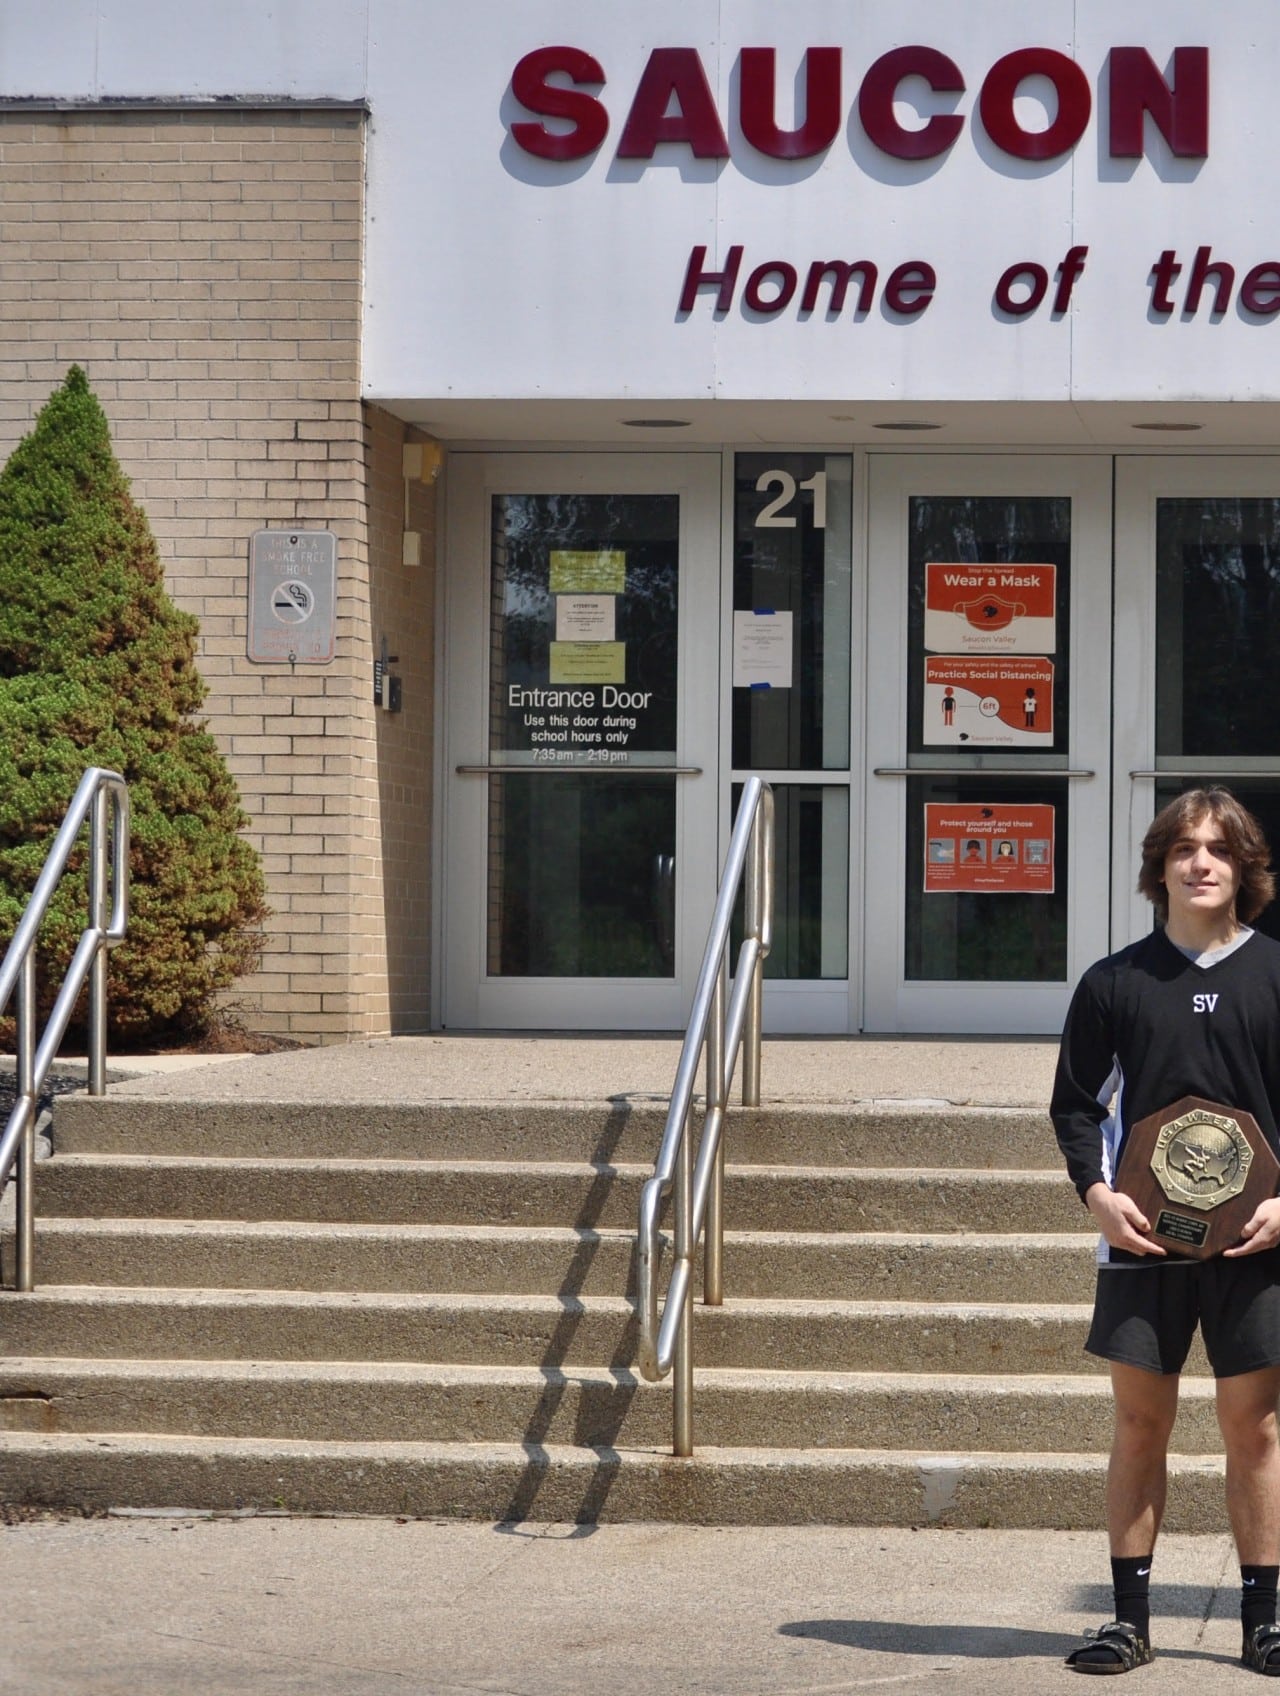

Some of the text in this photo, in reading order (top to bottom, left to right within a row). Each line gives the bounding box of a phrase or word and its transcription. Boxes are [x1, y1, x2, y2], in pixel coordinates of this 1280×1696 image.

[510, 45, 1209, 161] SAUCON
[680, 245, 937, 315] Home
[995, 245, 1089, 315] of
[755, 469, 826, 528] 21
[264, 552, 325, 562] SMOKE FREE
[274, 565, 312, 575] SCHOOL
[944, 574, 1040, 587] Wear a Mask
[962, 635, 1017, 645] Saucon Valley
[928, 670, 1051, 682] Practice Social Distancing
[508, 684, 652, 709] Entrance Door
[982, 702, 997, 710] 6ft
[524, 714, 636, 729] Use this door during
[531, 730, 629, 744] school hours only
[967, 820, 997, 828] yourself
[1193, 994, 1219, 1013] SV
[1157, 1113, 1249, 1173] USA WRESTLING
